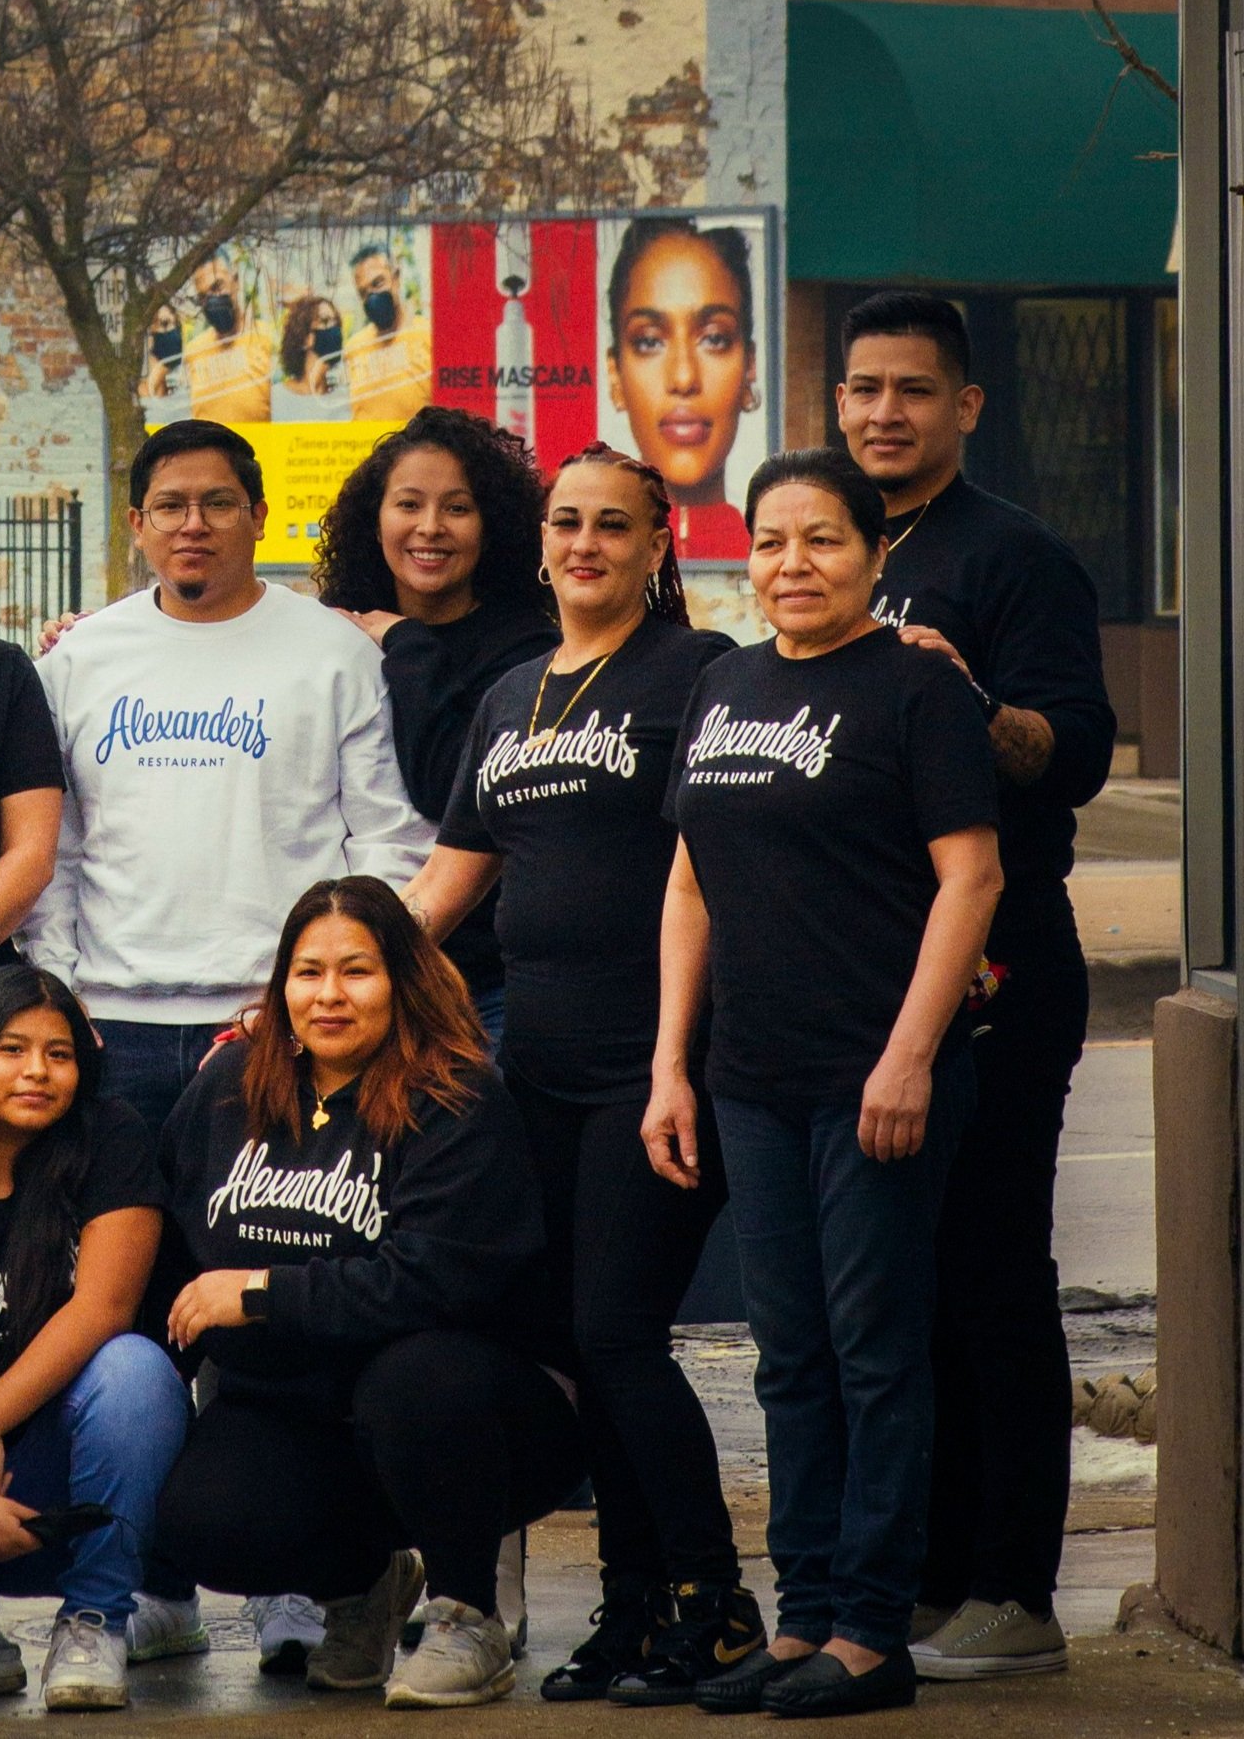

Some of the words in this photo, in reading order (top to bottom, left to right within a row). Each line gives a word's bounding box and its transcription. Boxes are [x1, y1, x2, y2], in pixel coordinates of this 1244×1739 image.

[438, 365, 483, 389] RISE
[488, 365, 592, 388] MASCARA
[95, 695, 272, 765] Alexander's
[685, 703, 842, 779] Alexander's
[137, 756, 226, 768] RESTAURANT
[476, 709, 640, 812] Alexander's
[687, 770, 775, 785] RESTAURANT
[496, 778, 588, 808] RESTAURANT
[207, 1138, 390, 1242] Alexander's
[238, 1223, 334, 1248] RESTAURANT
